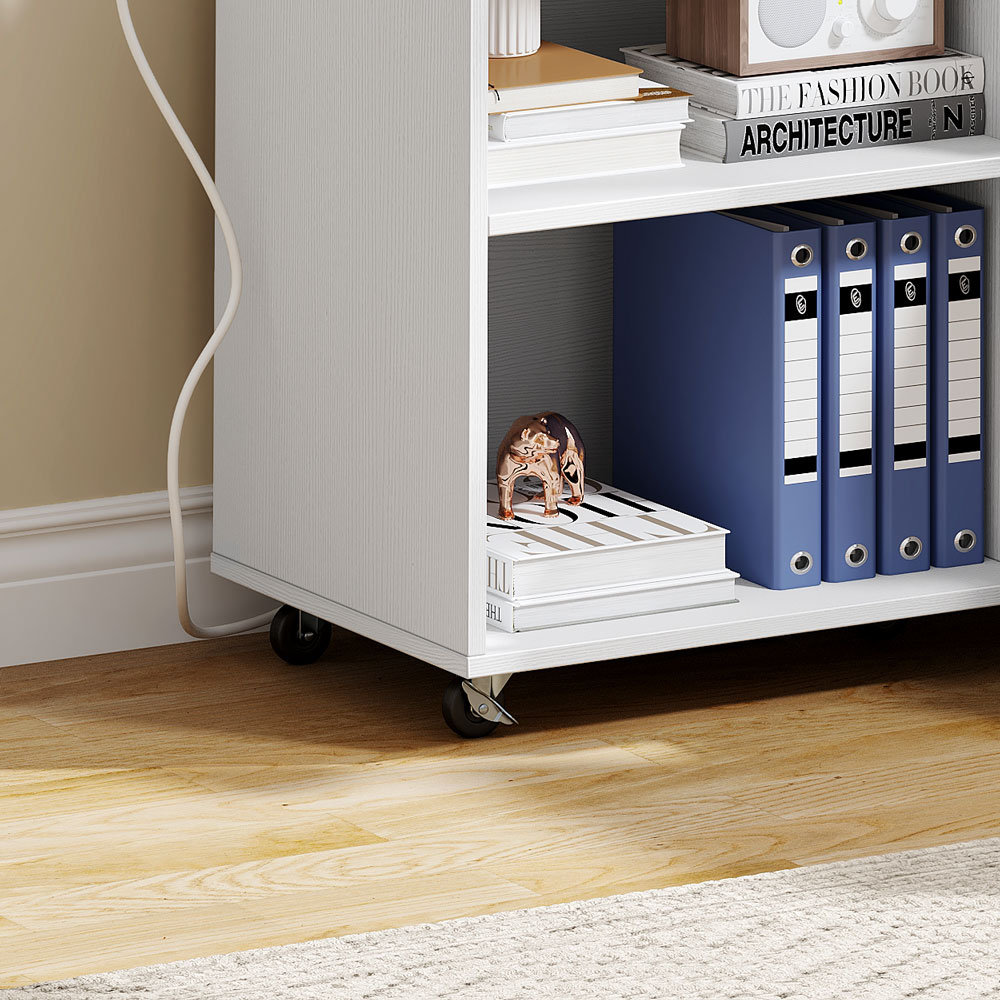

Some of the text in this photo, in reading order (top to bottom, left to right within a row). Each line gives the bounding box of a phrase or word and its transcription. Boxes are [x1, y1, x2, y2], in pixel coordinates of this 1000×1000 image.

[741, 64, 975, 114] THE FASHION BOOK
[740, 107, 913, 158] ARCHITECTURE
